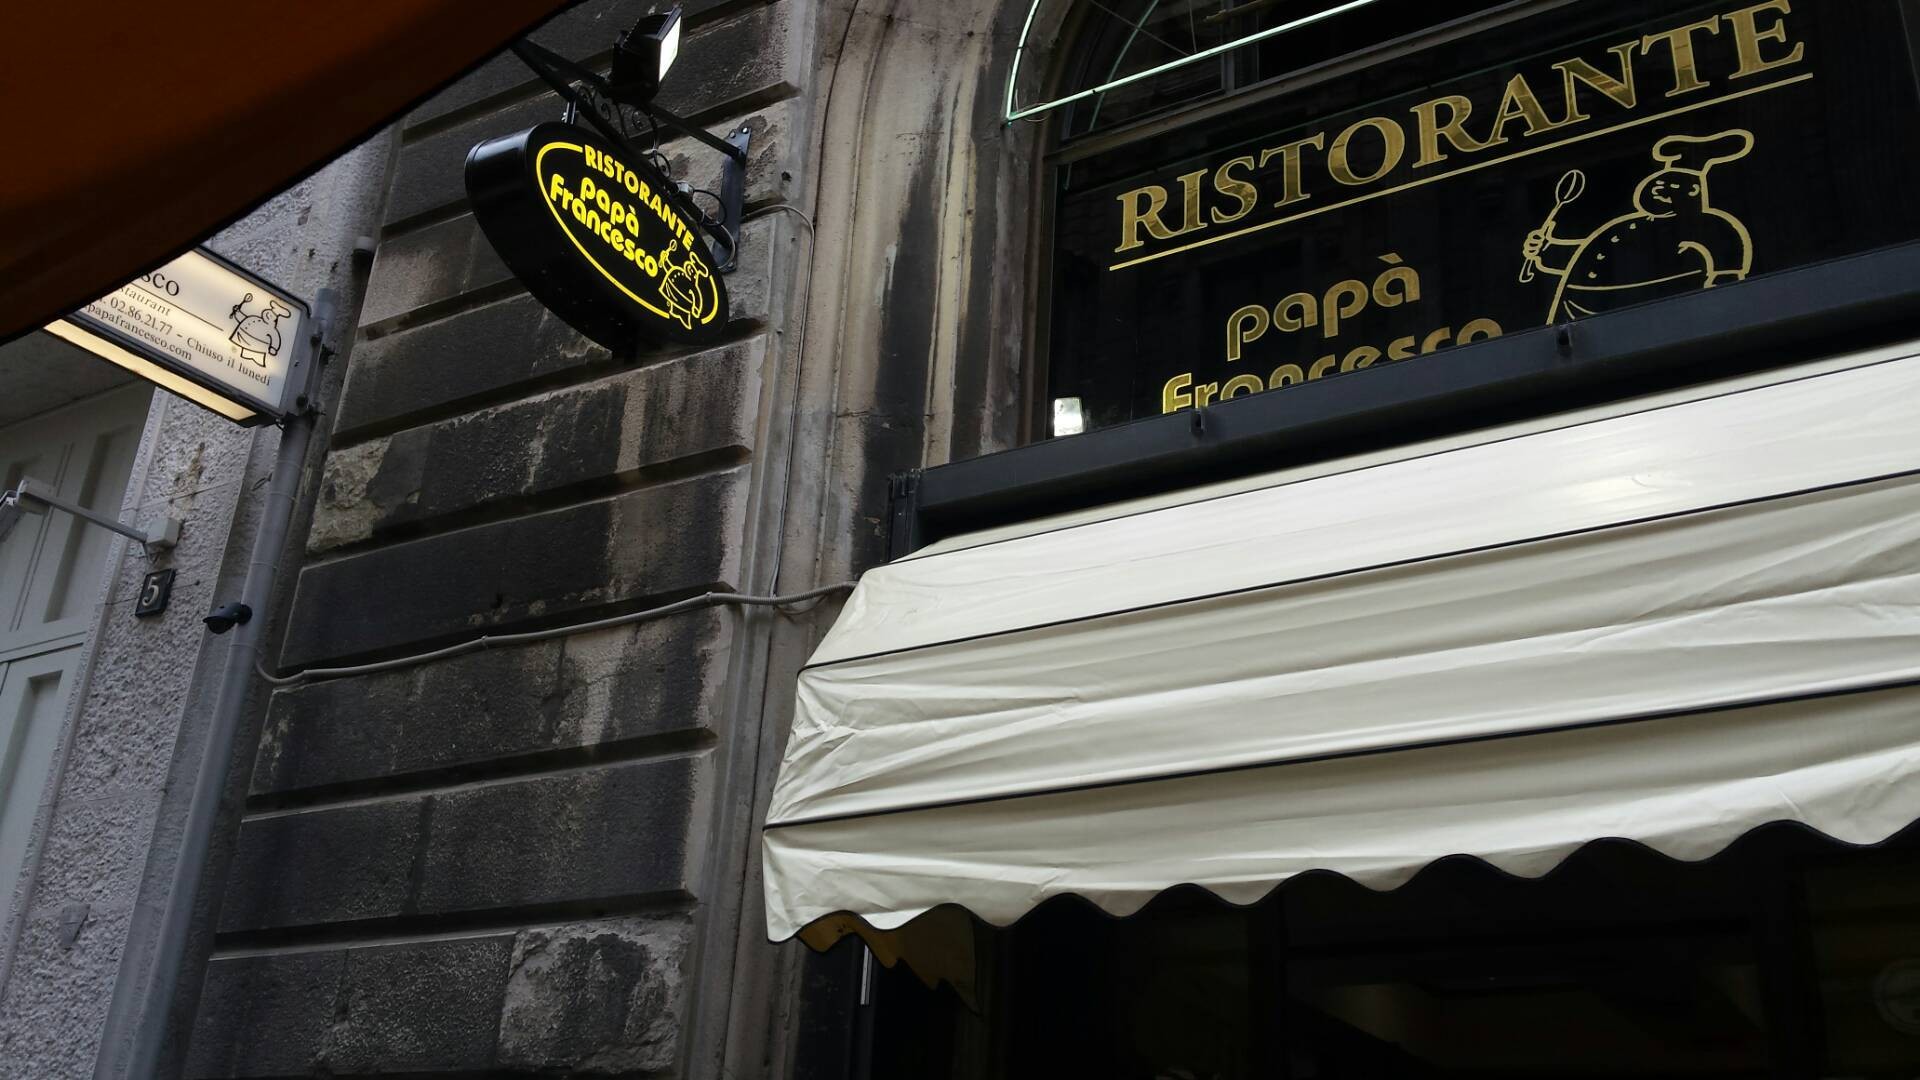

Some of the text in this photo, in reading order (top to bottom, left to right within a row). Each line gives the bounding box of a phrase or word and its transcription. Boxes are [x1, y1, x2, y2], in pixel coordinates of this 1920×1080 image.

[1114, 0, 1806, 254] RISTORANTE
[550, 174, 659, 278] Francesco
[580, 176, 639, 238] papà
[584, 144, 695, 252] RISTORANTE
[186, 337, 224, 362] Chiuso
[227, 356, 235, 368] il
[1226, 252, 1420, 363] papà
[142, 576, 160, 607] 5
